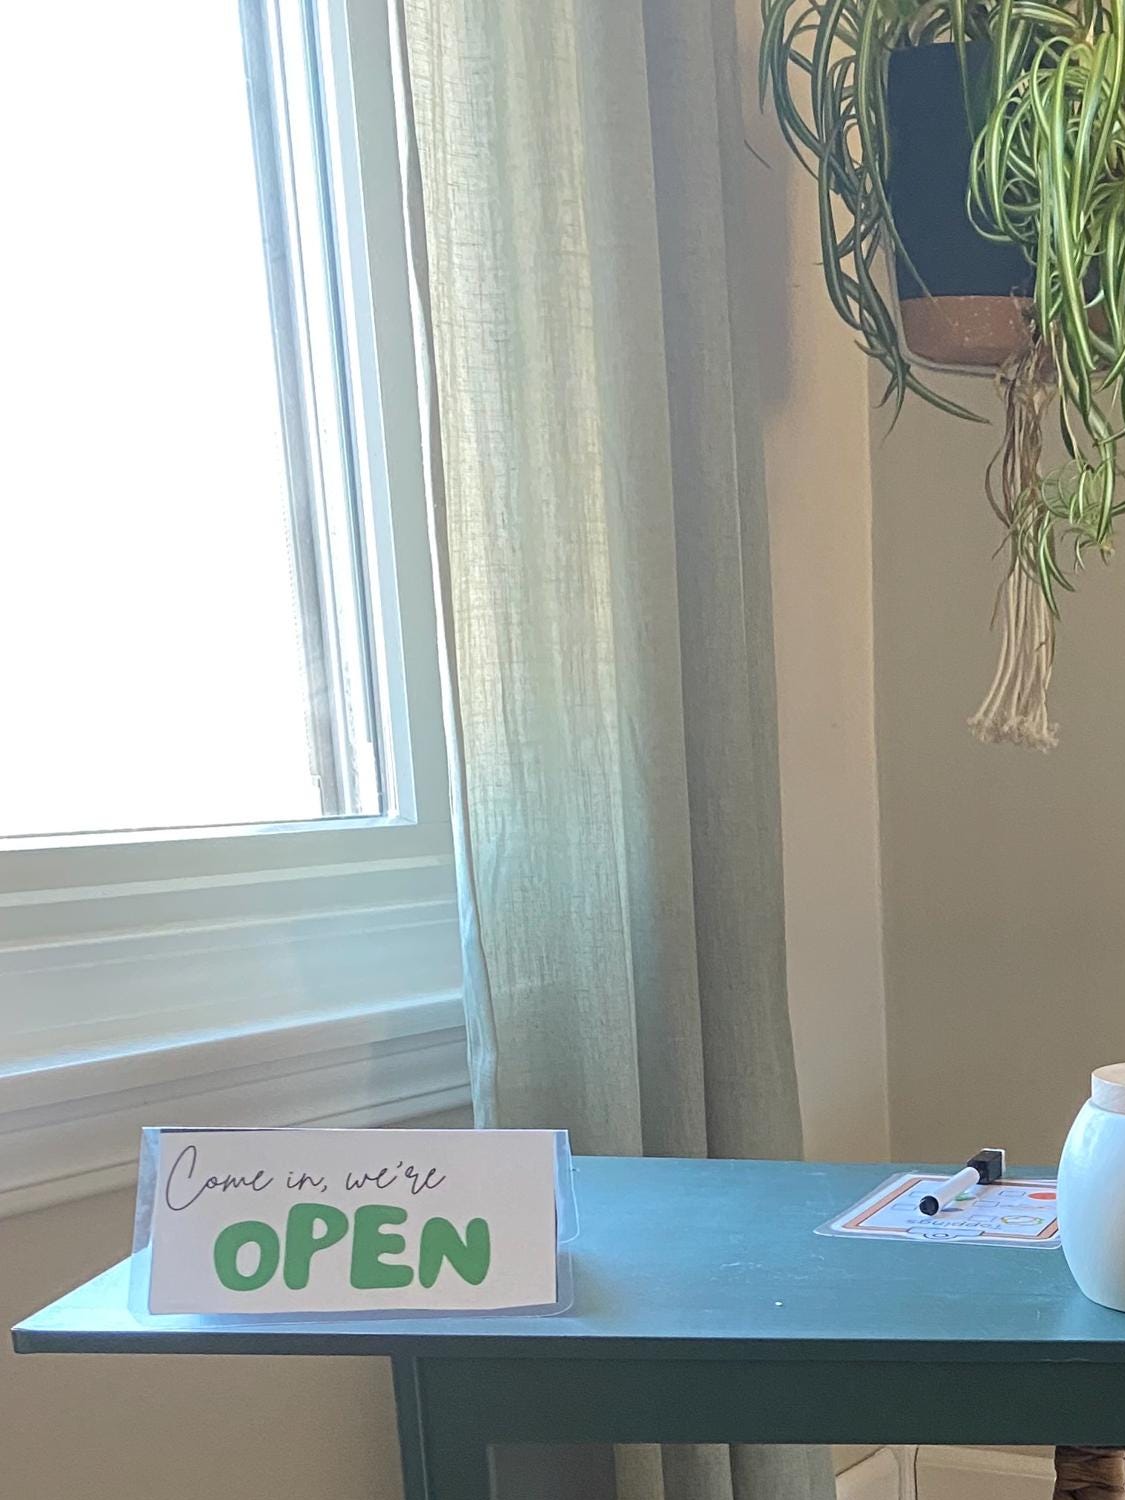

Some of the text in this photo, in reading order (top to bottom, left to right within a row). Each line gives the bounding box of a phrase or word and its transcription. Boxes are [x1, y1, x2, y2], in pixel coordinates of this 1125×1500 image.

[166, 1145, 447, 1212] Come in, we're
[212, 1203, 491, 1292] OPEN
